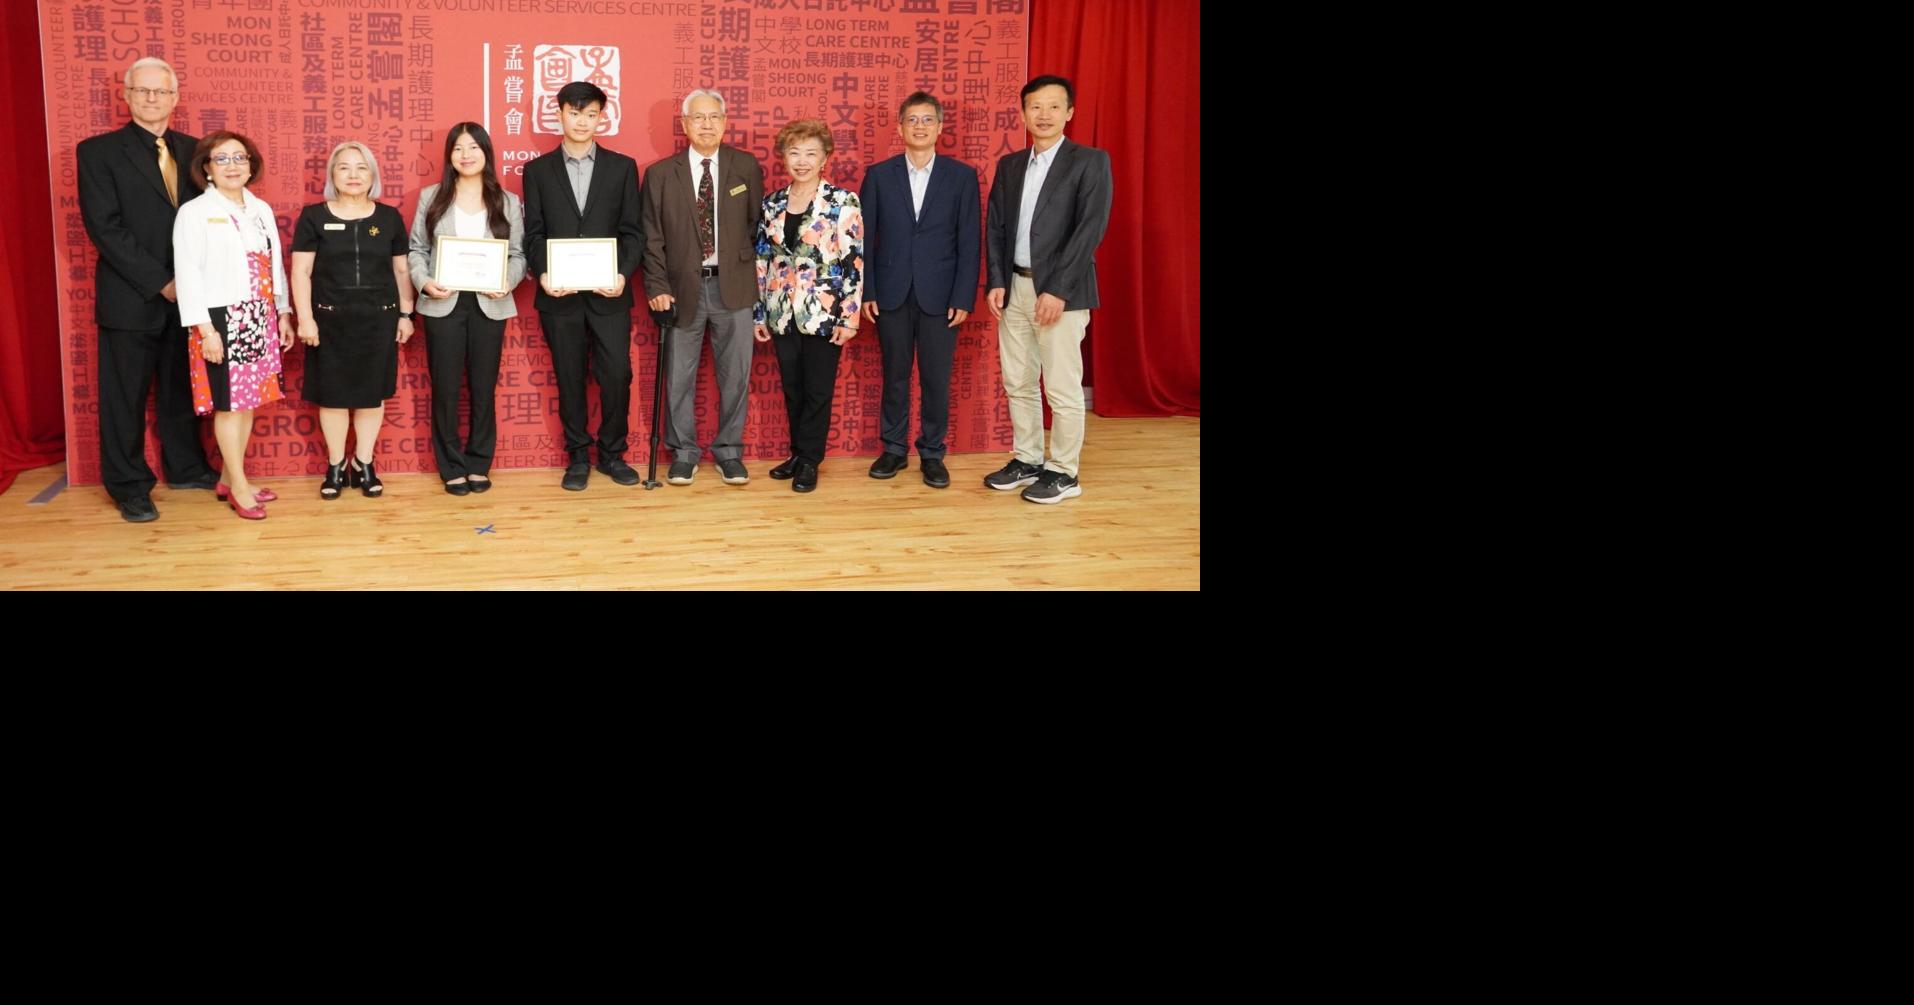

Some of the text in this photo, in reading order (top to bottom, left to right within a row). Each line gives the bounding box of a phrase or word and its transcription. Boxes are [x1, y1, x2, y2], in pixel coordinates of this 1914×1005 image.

[170, 0, 186, 39] GROU
[434, 0, 541, 13] VOLUNTEER
[544, 1, 626, 15] SERVICES
[629, 3, 697, 17] CENTRE
[71, 4, 109, 61] 護理
[110, 0, 142, 61] SCH
[226, 16, 272, 30] MON
[806, 18, 890, 32] LONG TERM
[49, 6, 69, 89] VOLUNTEER
[191, 32, 273, 47] SHEONG
[805, 34, 912, 49] CARE CENTRE
[206, 49, 273, 63] COURT
[330, 36, 345, 80] TERM
[699, 43, 716, 90] CARE
[768, 58, 801, 70] MON
[803, 51, 910, 70] 長期護理中心
[994, 20, 1021, 104] 義工服務
[193, 66, 293, 80] COMMUNITY &
[348, 12, 365, 129] CARE CENTRE
[768, 72, 828, 85] SHEONG
[210, 80, 295, 93] VOLUNTEER
[407, 15, 435, 177] 長期護理中心
[504, 44, 524, 135] 孟嘗會
[768, 86, 816, 98] COURT
[863, 74, 877, 110] CARE
[940, 19, 960, 149] CARE CENTRE
[180, 91, 295, 105] ERVICES CENTRE
[300, 11, 329, 195] 社區及義工服務中心
[331, 84, 346, 129] LONG
[876, 74, 890, 128] CENTRE
[863, 112, 877, 138] DAY
[502, 151, 541, 161] MON
[501, 353, 552, 367] SERVIC
[252, 415, 317, 438] GRO
